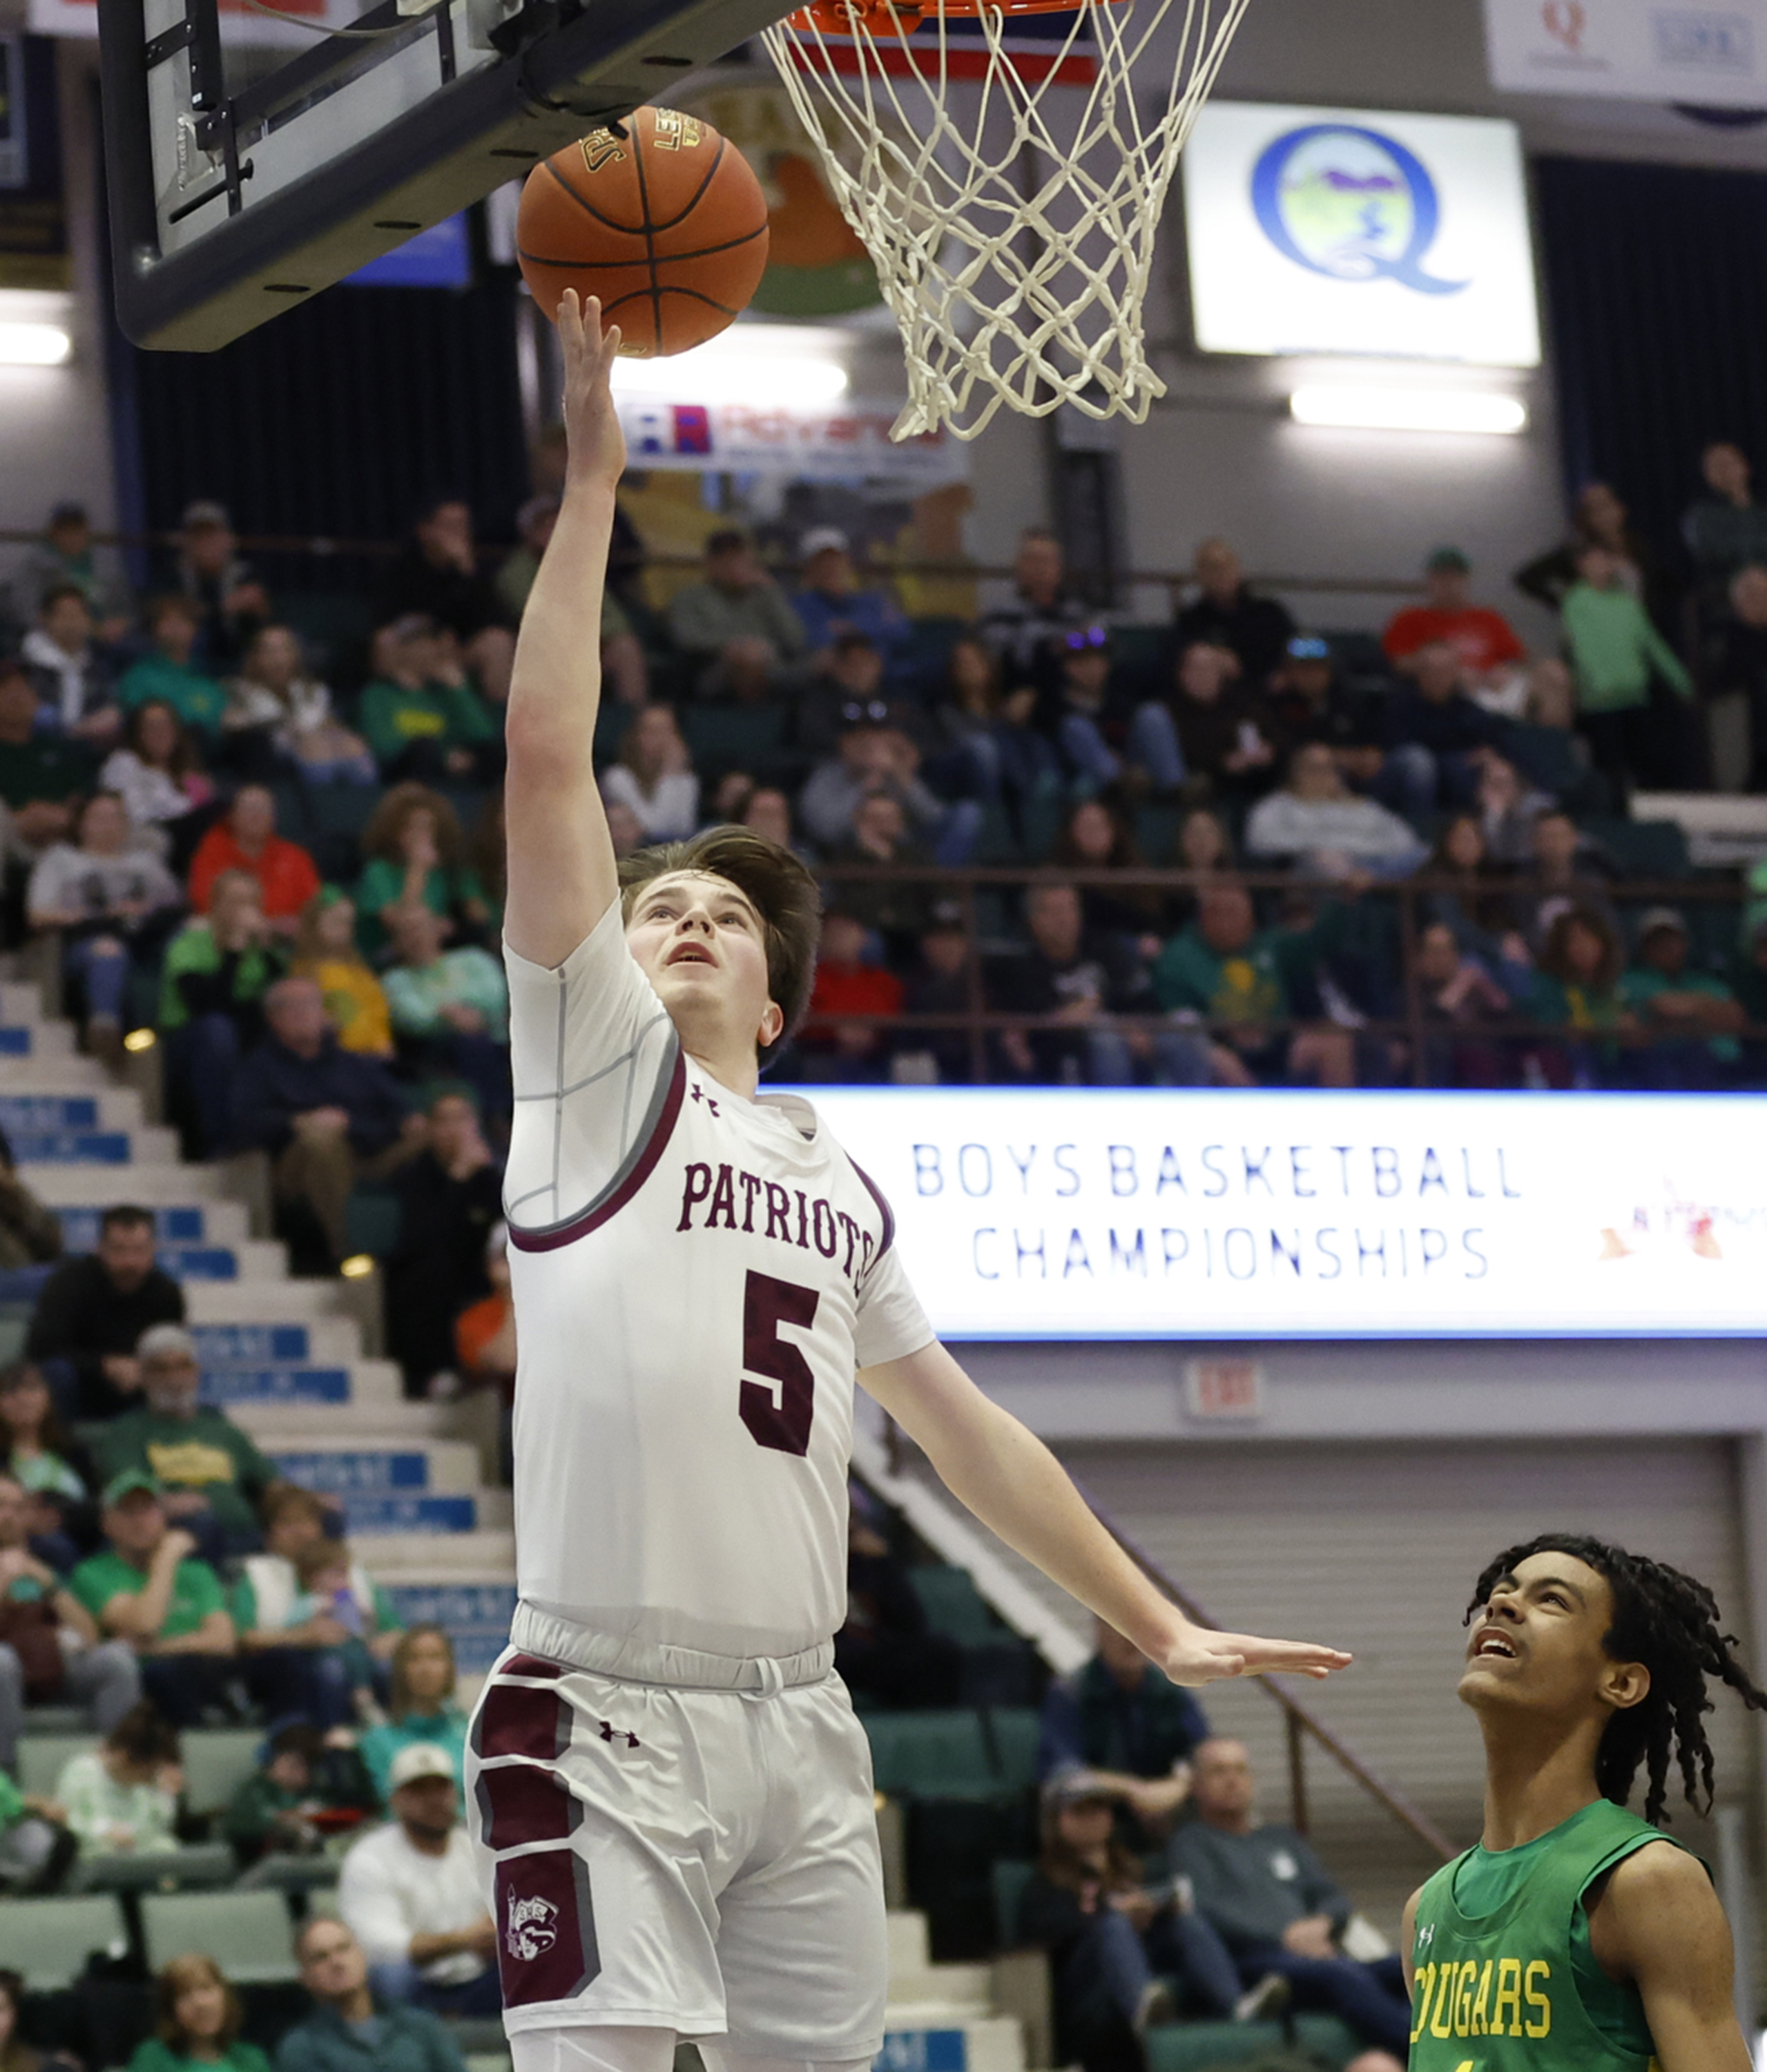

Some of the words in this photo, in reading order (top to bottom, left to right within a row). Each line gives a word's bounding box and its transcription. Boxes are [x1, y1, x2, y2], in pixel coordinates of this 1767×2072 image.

[912, 1143, 1081, 1197] BOYS
[1108, 1144, 1522, 1198] BASKETBALL
[974, 1227, 1488, 1280] CHAMPIONSHIPS
[739, 1269, 820, 1457] 5
